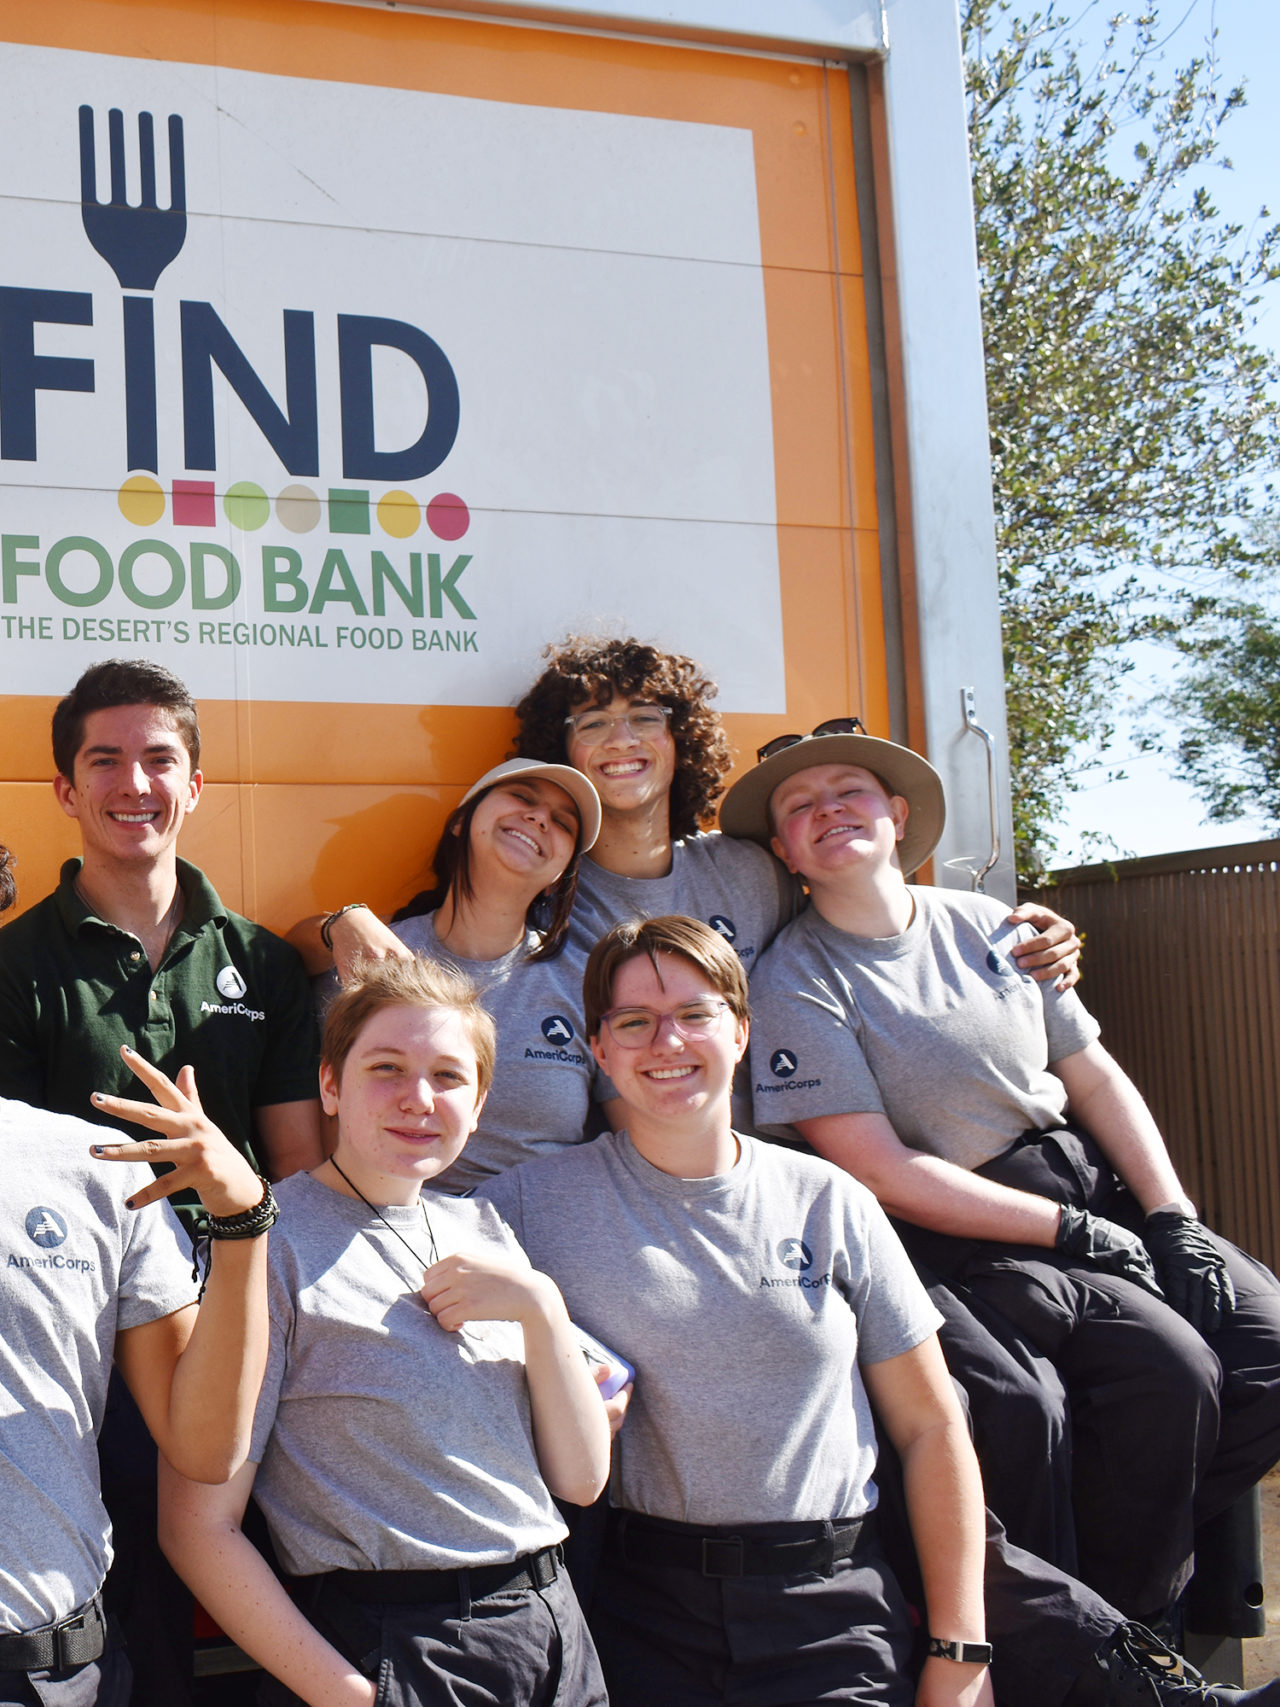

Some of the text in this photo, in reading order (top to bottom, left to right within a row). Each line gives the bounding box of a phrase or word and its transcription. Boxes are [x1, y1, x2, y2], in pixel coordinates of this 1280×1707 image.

[1, 533, 478, 620] FOOD BANK
[1, 615, 479, 653] THE DESERT'S REGIONAL FOOD BANK
[756, 1078, 822, 1093] AmeriCorps
[6, 1253, 96, 1274] AmeriCorps
